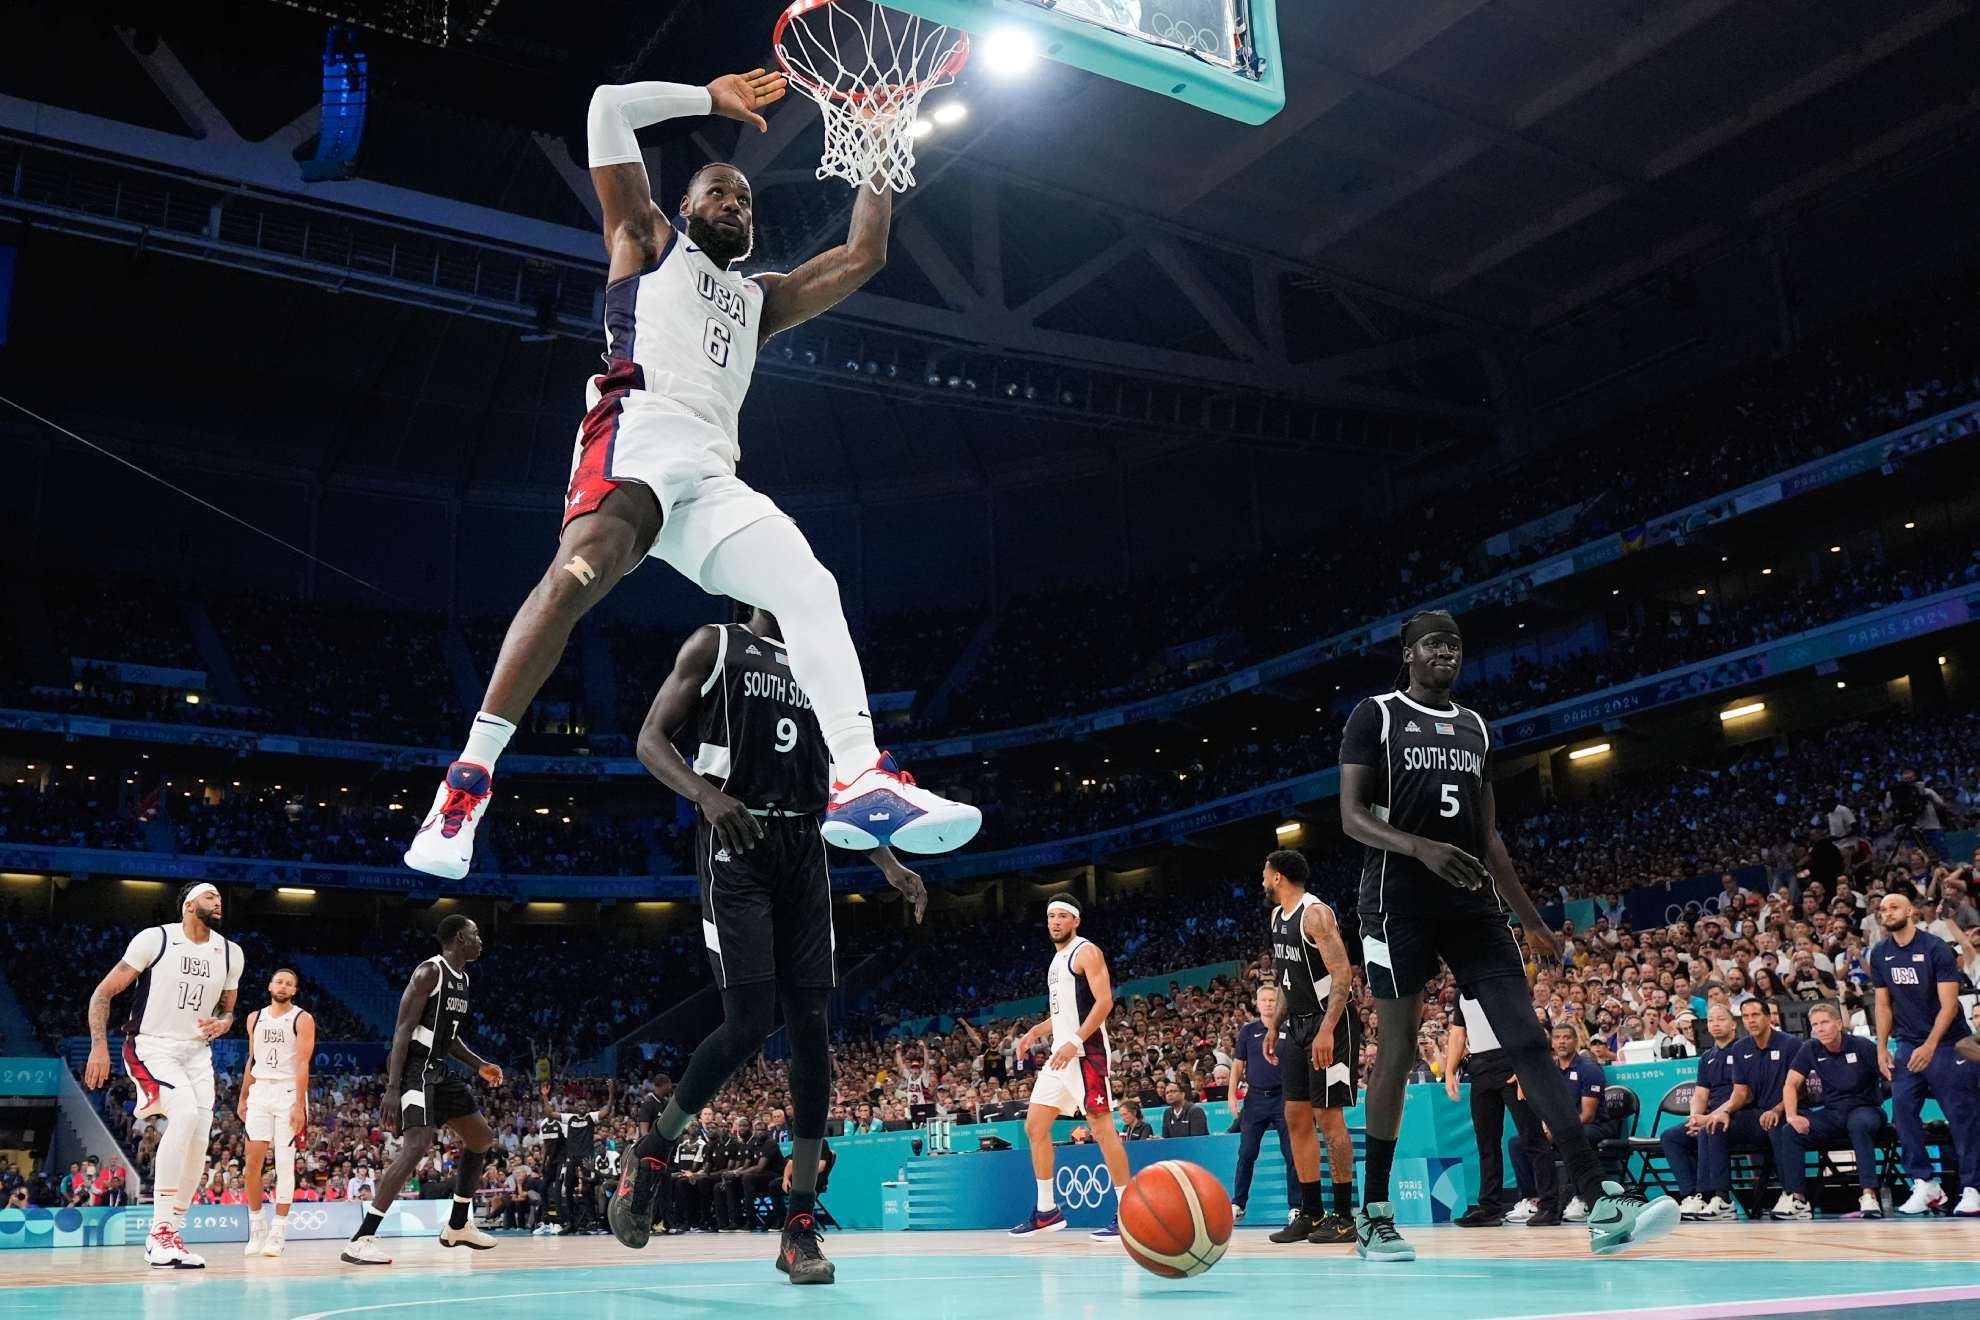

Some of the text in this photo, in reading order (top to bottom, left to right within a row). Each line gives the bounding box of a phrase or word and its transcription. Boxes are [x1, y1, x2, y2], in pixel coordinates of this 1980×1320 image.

[698, 271, 746, 327] USA
[703, 317, 731, 368] 6
[1848, 608, 1948, 644] PARIS 2024
[744, 671, 814, 710] SOUTH SUD
[1563, 695, 1639, 724] PARIS 2024
[774, 717, 798, 753] 9
[1403, 746, 1482, 778] SOUTH SUDAN
[1440, 784, 1461, 818] 5
[180, 956, 211, 978] USA
[1891, 967, 1919, 985] USA
[1282, 967, 1292, 991] 4
[178, 982, 204, 1012] 14
[263, 1028, 285, 1043] USA
[451, 1020, 459, 1040] 7
[266, 1047, 279, 1069] 4
[315, 1052, 358, 1067] 024
[1616, 1070, 1665, 1080] PARIS 2024
[1676, 1067, 1698, 1075] PARI
[1675, 1096, 1691, 1104] 20
[1399, 1181, 1423, 1190] PARIS
[1400, 1191, 1424, 1201] 2024
[194, 1217, 240, 1229] 2024
